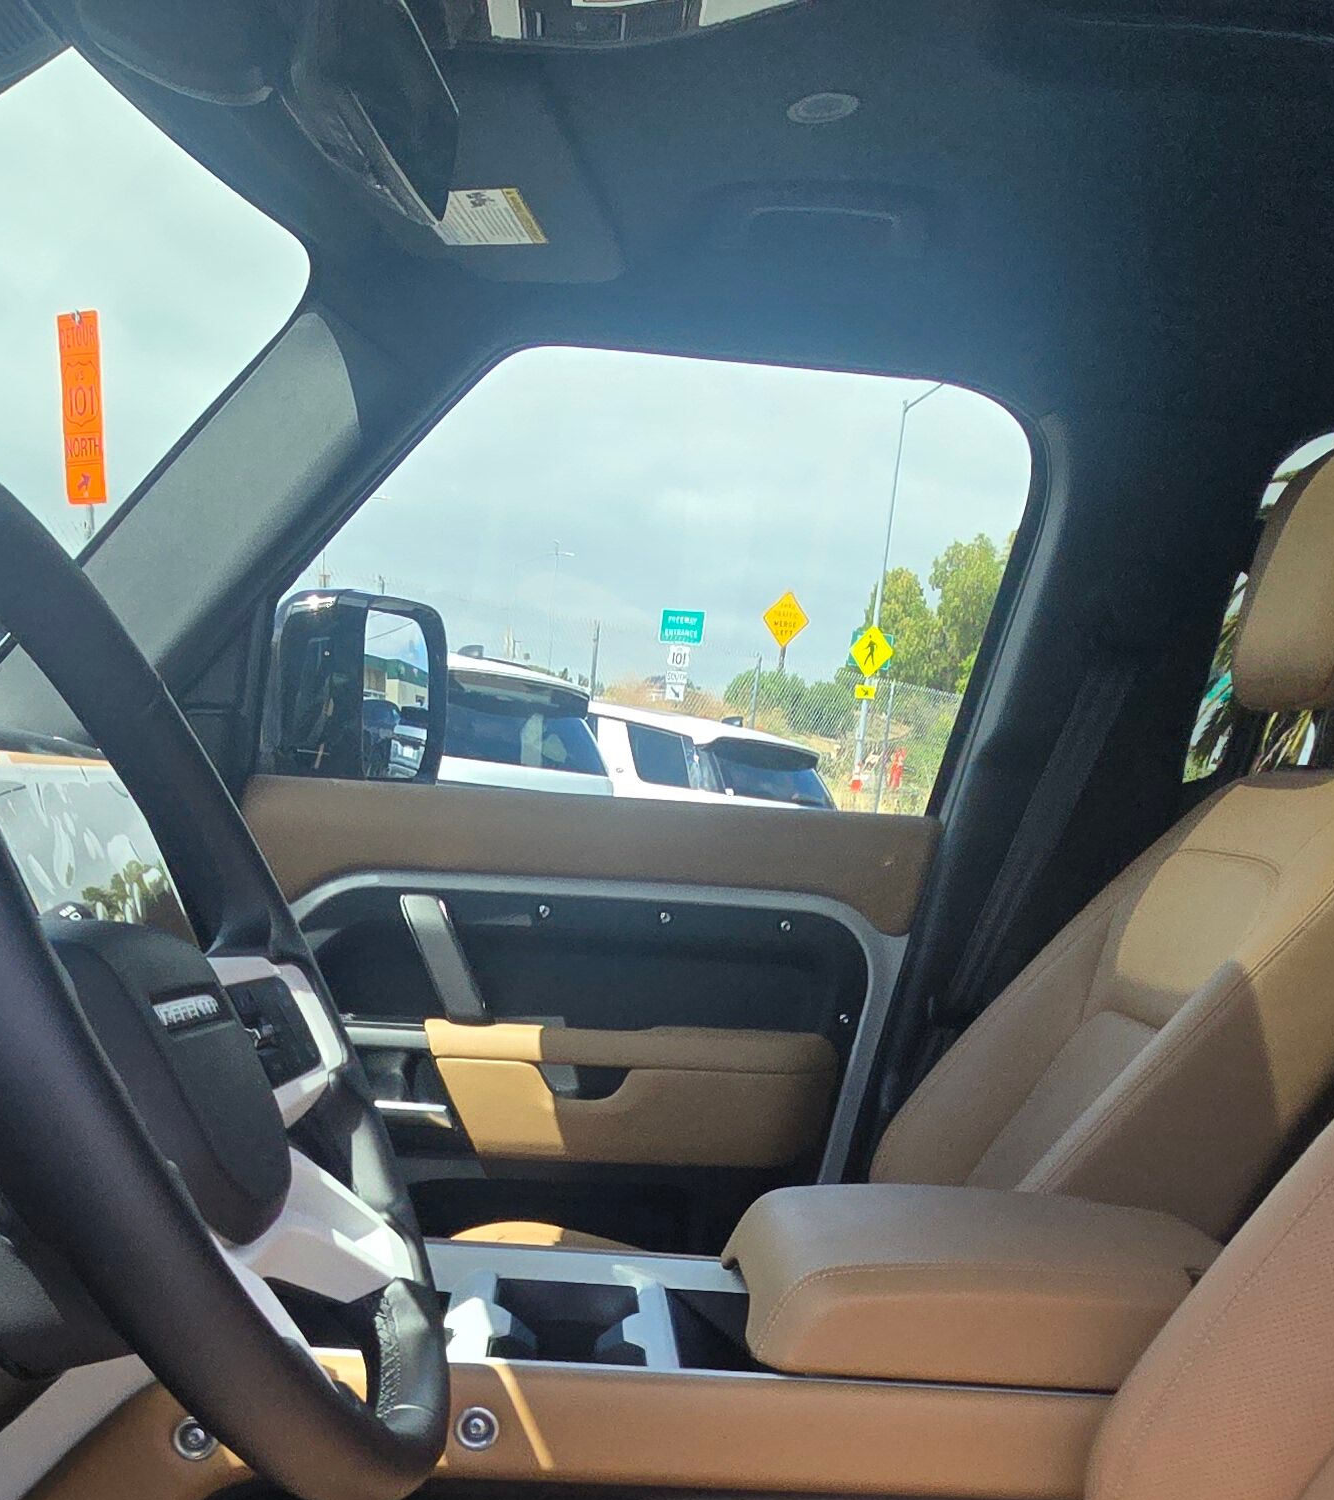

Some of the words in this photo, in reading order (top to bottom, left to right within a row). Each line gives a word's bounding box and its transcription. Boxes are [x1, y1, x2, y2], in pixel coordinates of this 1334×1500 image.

[61, 325, 95, 348] DETOUR
[69, 385, 94, 416] 101
[67, 436, 99, 458] NORTH
[667, 615, 698, 625] FREEWAY
[774, 620, 797, 628] MERGE
[665, 628, 698, 638] ENTRANCE
[671, 652, 687, 665] 101
[667, 671, 688, 681] SOUTH
